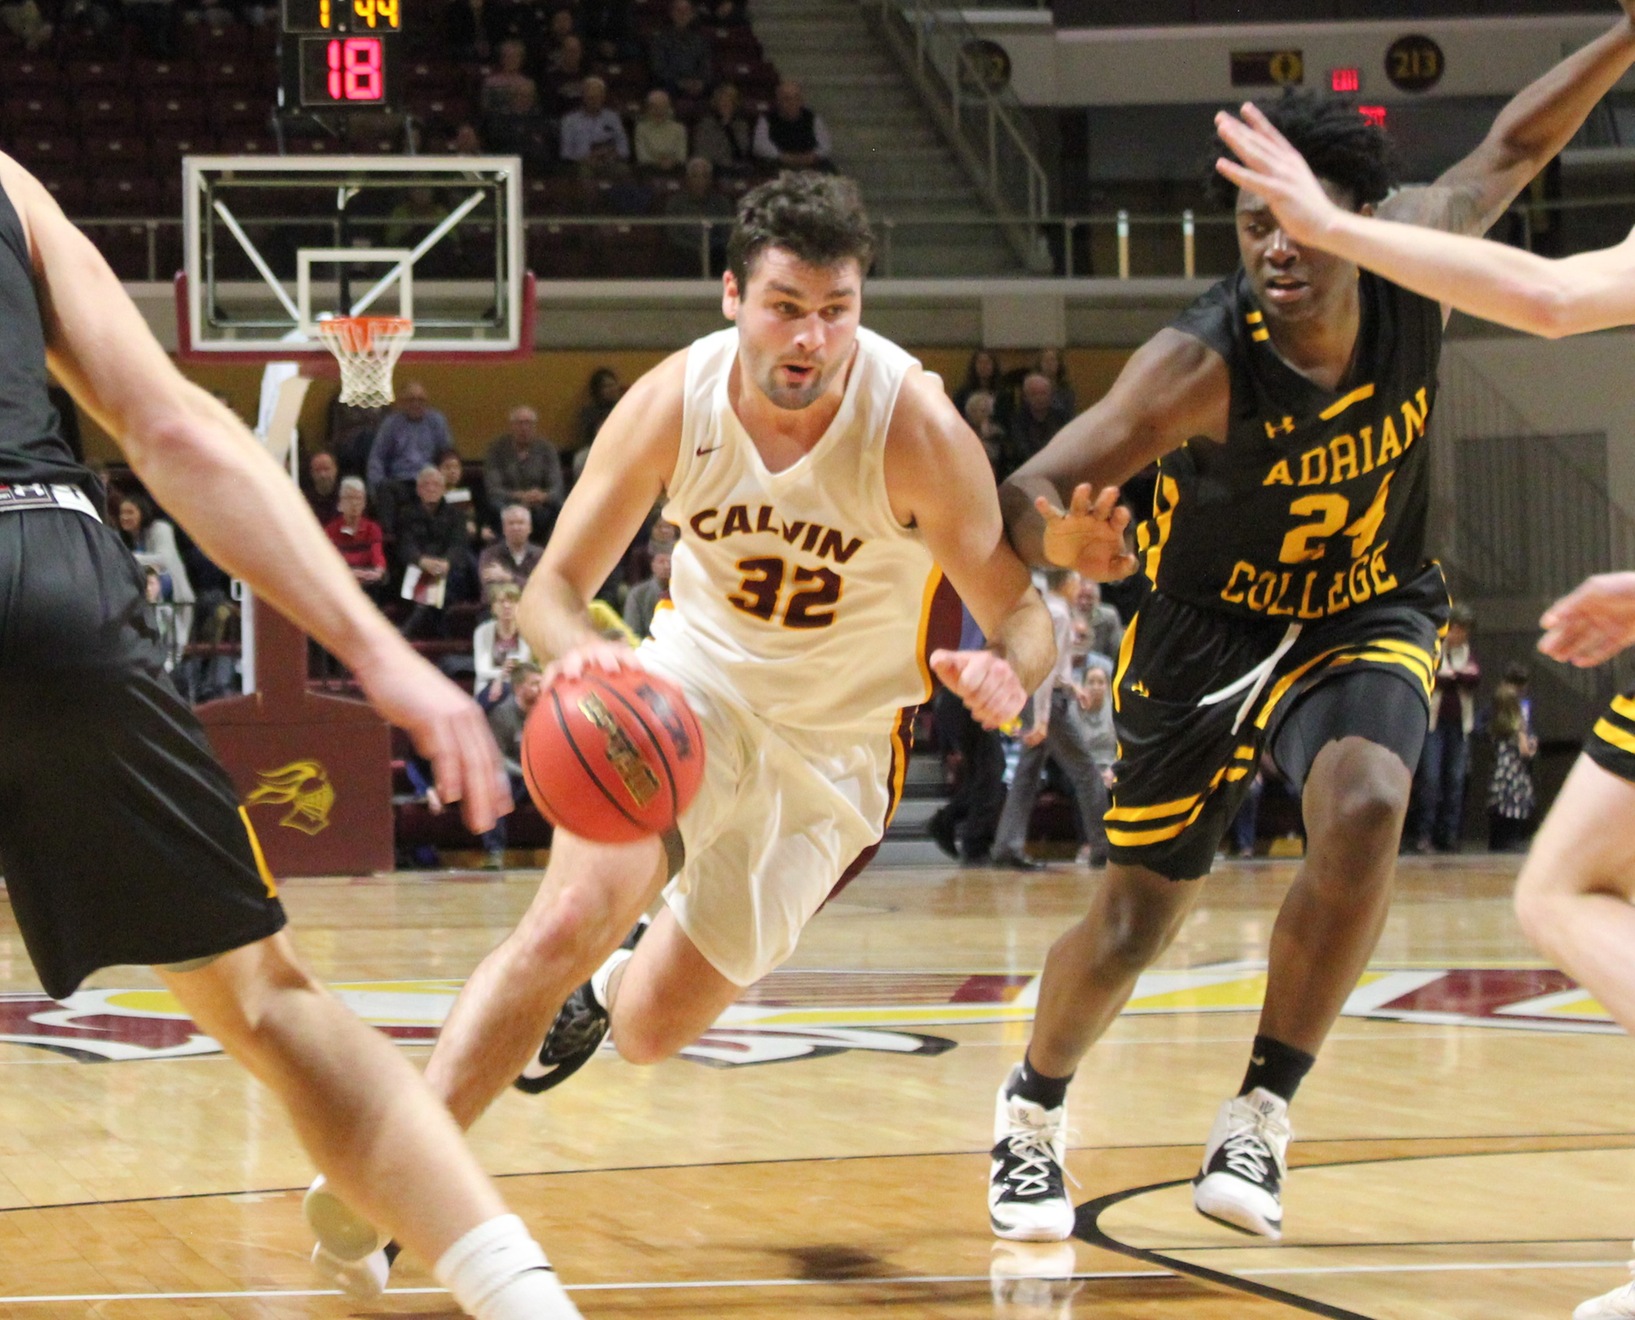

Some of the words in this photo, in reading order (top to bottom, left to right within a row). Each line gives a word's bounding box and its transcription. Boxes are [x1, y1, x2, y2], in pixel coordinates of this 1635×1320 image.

[326, 37, 382, 100] 18
[1393, 50, 1438, 79] 213
[1262, 386, 1428, 487] ADRIAN
[689, 504, 863, 565] CALVIN
[727, 555, 843, 629] 32
[1220, 540, 1398, 619] COLLEGE
